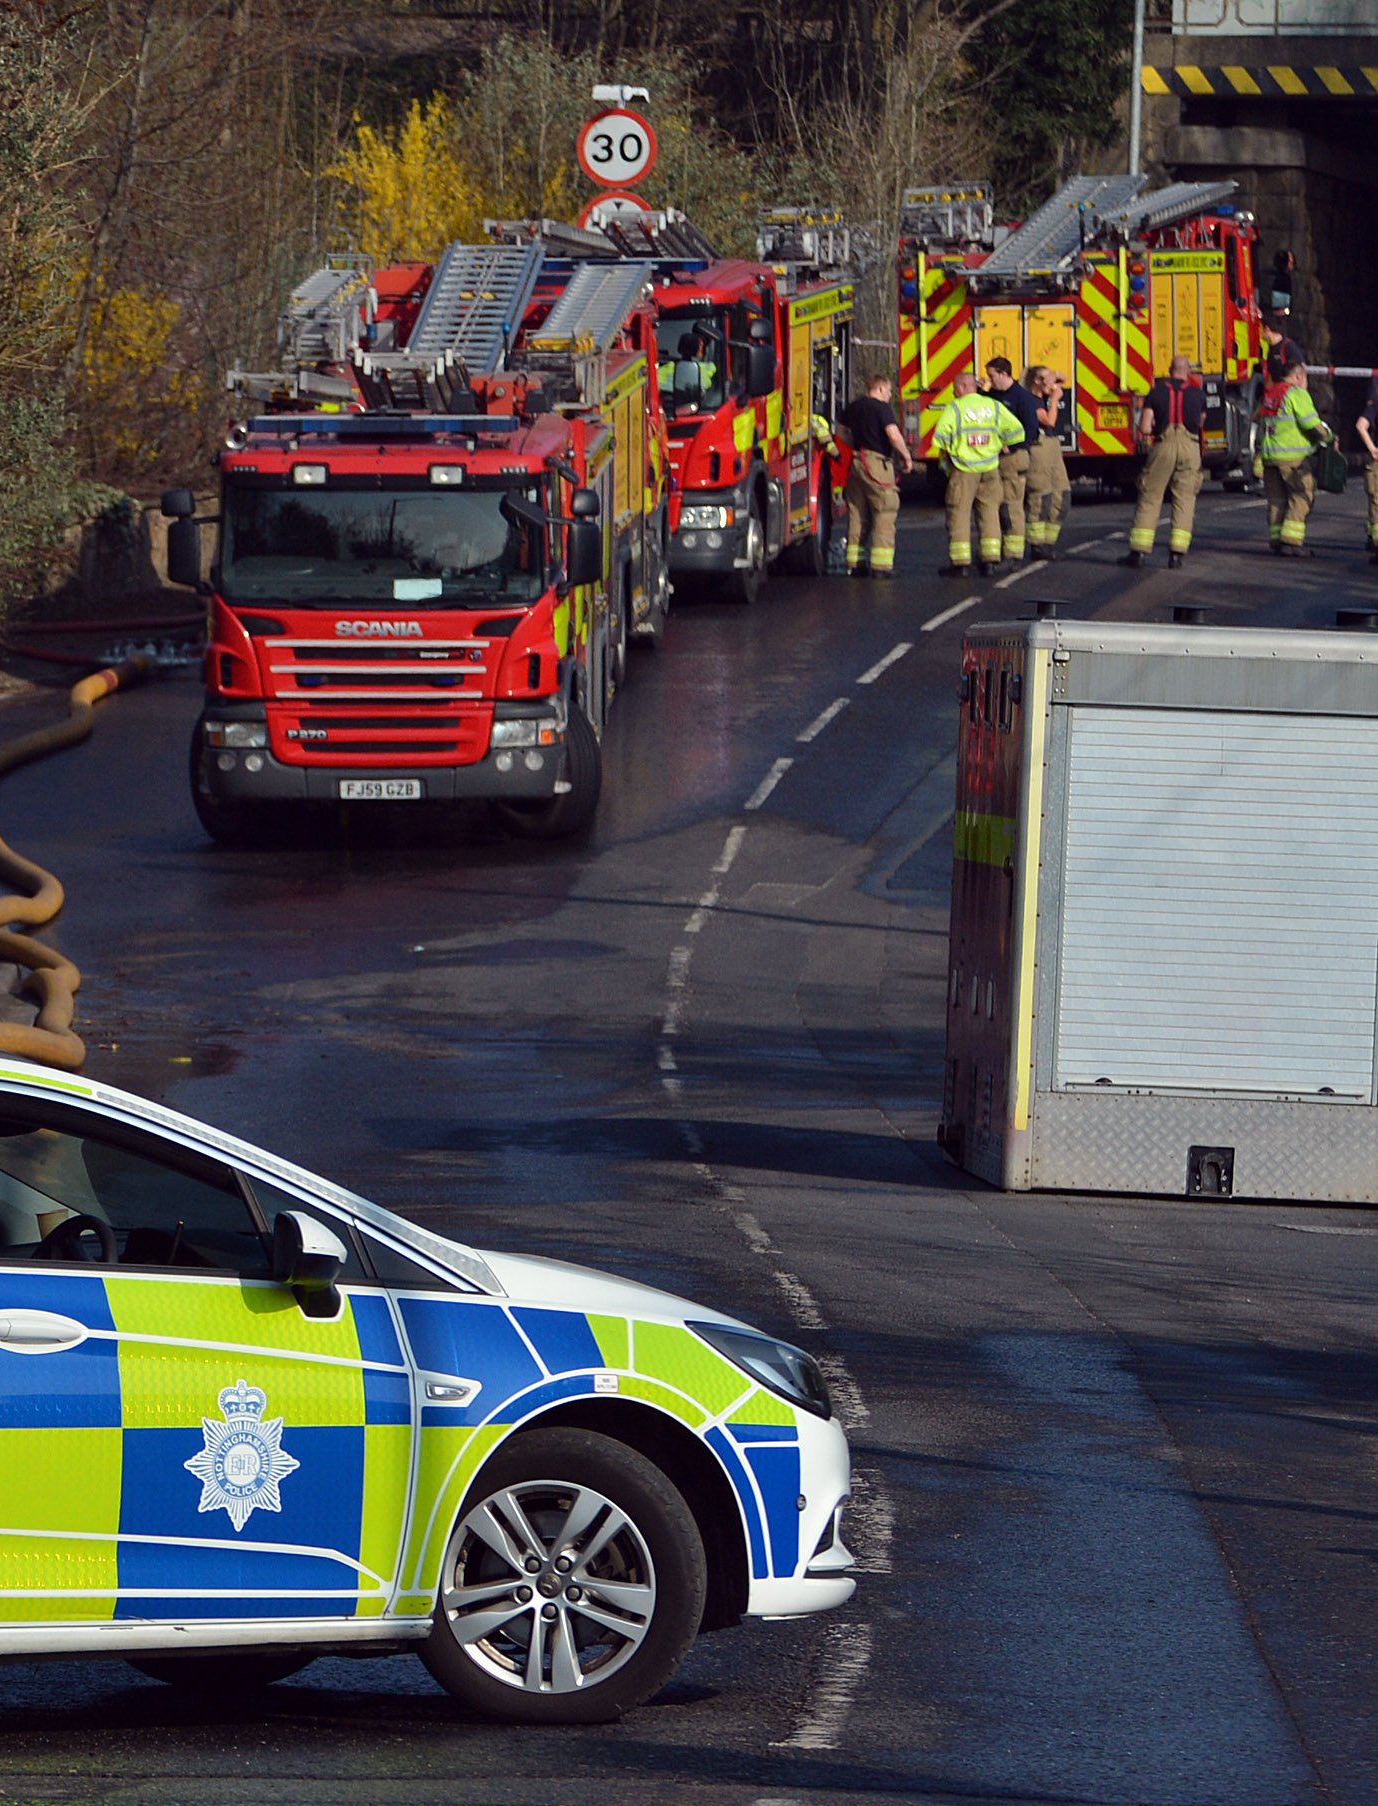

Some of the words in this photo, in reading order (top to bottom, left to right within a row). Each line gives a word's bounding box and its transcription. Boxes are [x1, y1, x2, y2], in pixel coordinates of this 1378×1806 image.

[592, 133, 642, 163] 30
[335, 620, 424, 637] SCANIA
[346, 783, 383, 797] FJ59
[386, 783, 414, 797] GZB
[215, 1433, 270, 1481] NOTTINGHAMSHIRE
[224, 1482, 259, 1497] POLICE
